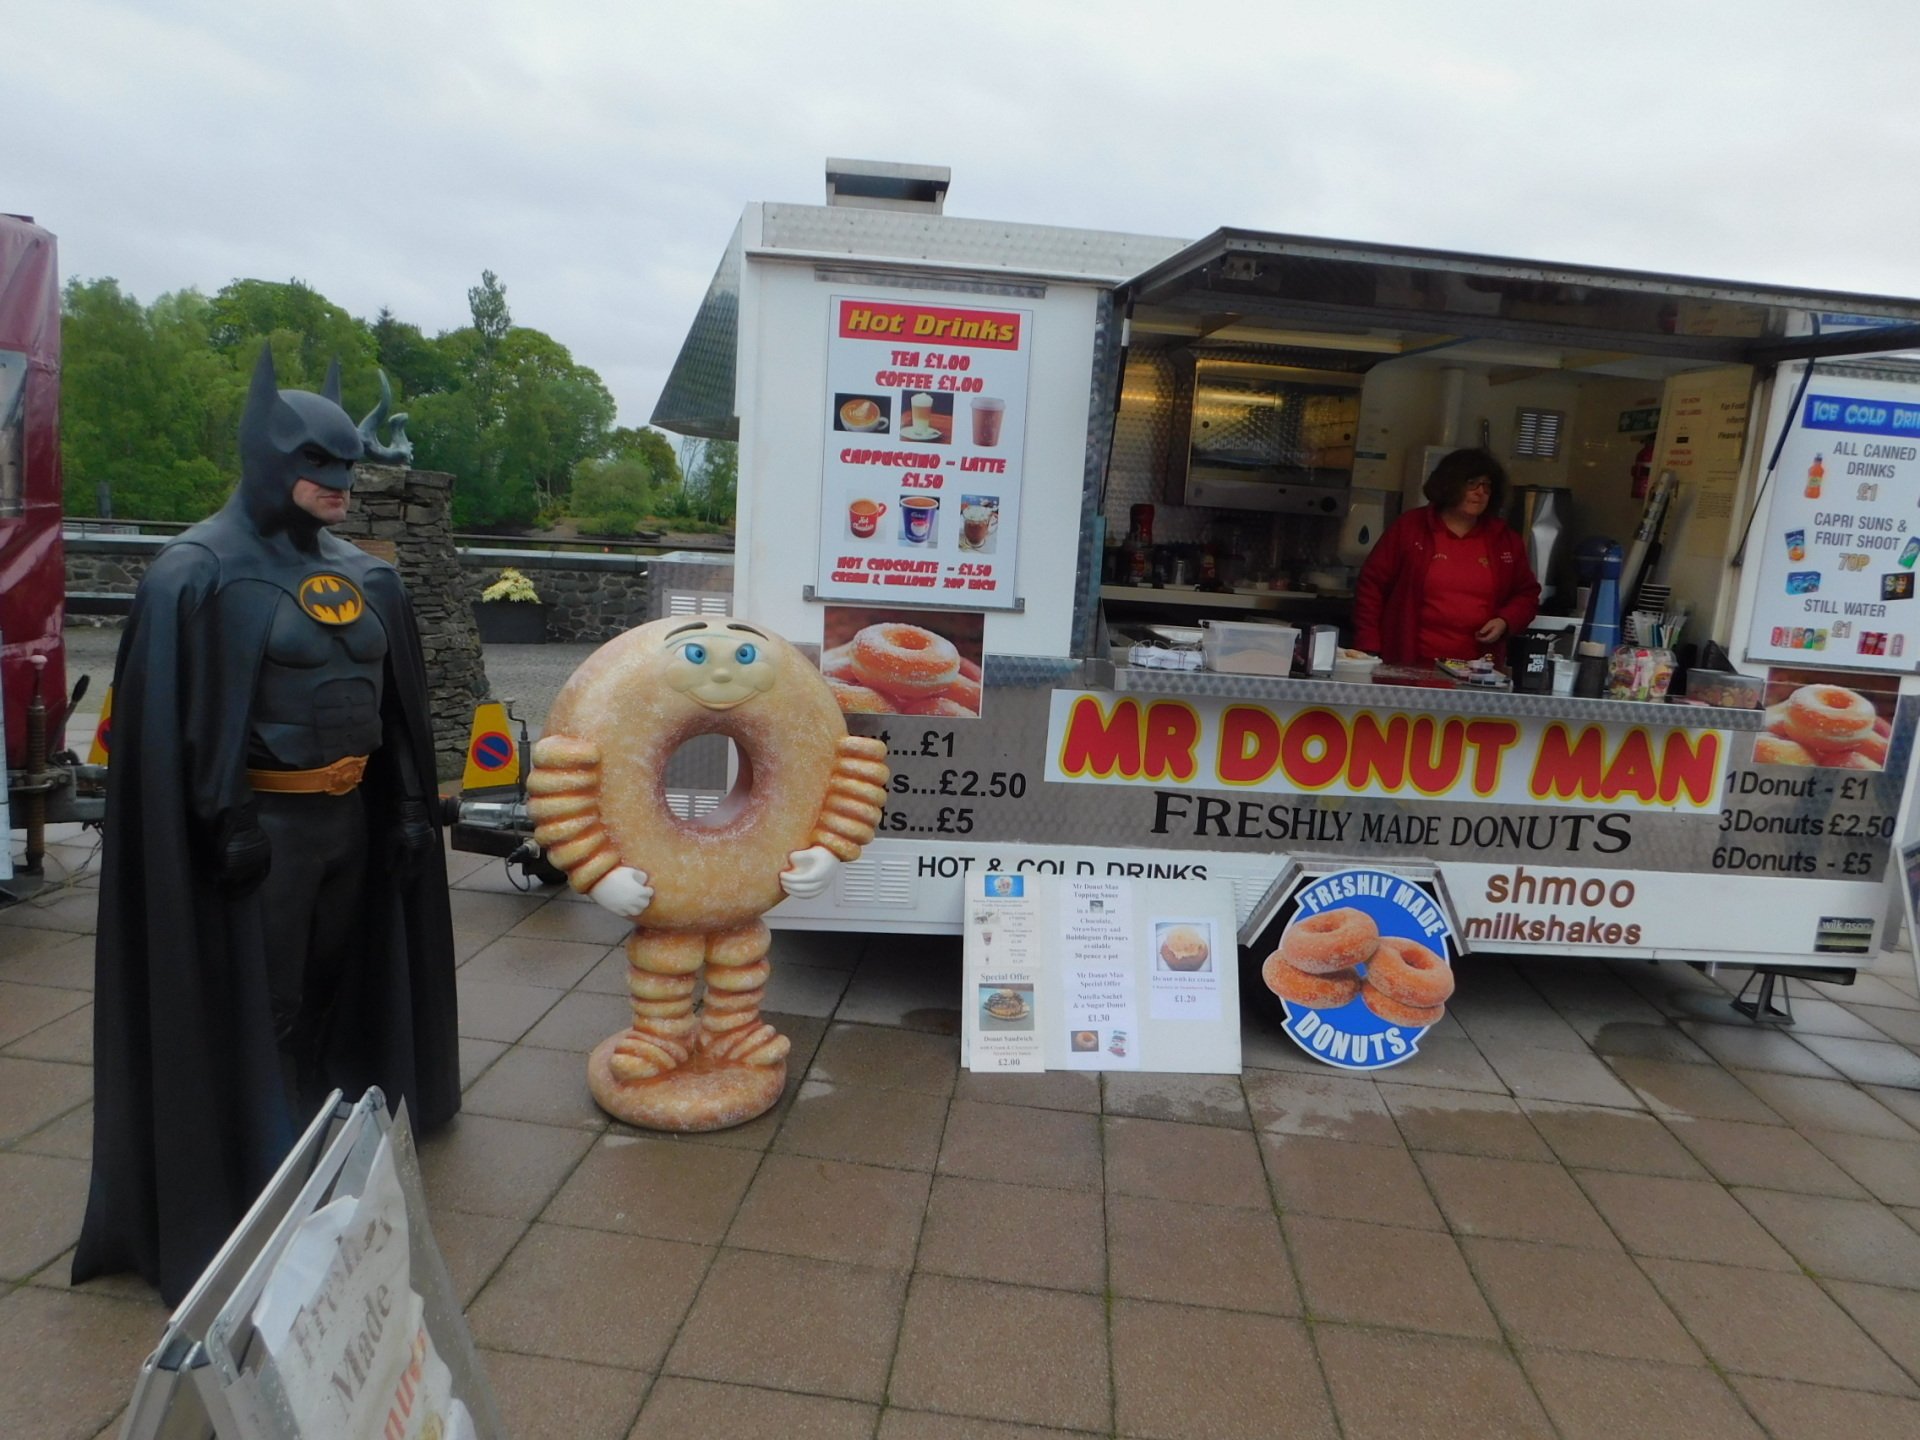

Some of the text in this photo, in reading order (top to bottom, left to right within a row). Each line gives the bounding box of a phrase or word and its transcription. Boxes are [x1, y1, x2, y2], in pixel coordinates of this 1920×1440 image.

[848, 309, 1015, 342] Hot Drinks
[891, 350, 971, 371] TEA £1.00
[875, 371, 984, 393] COFFEE £1.00
[1812, 401, 1840, 422] ICE
[1844, 405, 1887, 426] COLD
[840, 448, 941, 469] CAPPUCCINO
[960, 457, 1007, 473] LATTE
[1833, 441, 1917, 462] ALL CANNED
[901, 472, 944, 489] £1.50
[1847, 461, 1896, 479] DRINKS
[1856, 483, 1879, 502] £1
[1814, 512, 1907, 533] CAPRI SUNS &
[1814, 531, 1853, 547] FRUIT
[1857, 535, 1901, 551] SHOOT
[837, 556, 864, 569] HOT
[867, 558, 939, 573] CHOCOLATE
[958, 562, 992, 577] £1.50
[1803, 598, 1886, 618] STILL WATER
[1831, 620, 1853, 639] £1
[1060, 695, 1722, 807] MR DONUT MAN
[1840, 777, 1869, 800] £1
[1150, 790, 1632, 854] FRESHLY MADE DONUTS
[1828, 813, 1896, 839] £2.50
[918, 856, 975, 878] HOT
[1106, 862, 1208, 881] DRINKS
[1841, 852, 1873, 875] £5
[1485, 866, 1636, 909] shmoo
[1304, 874, 1445, 939] FRESHLY MADE
[1462, 912, 1643, 946] milkshakes
[980, 972, 1031, 982] Special Offer
[1294, 1010, 1407, 1063] DONUTS
[330, 1284, 392, 1424] Made
